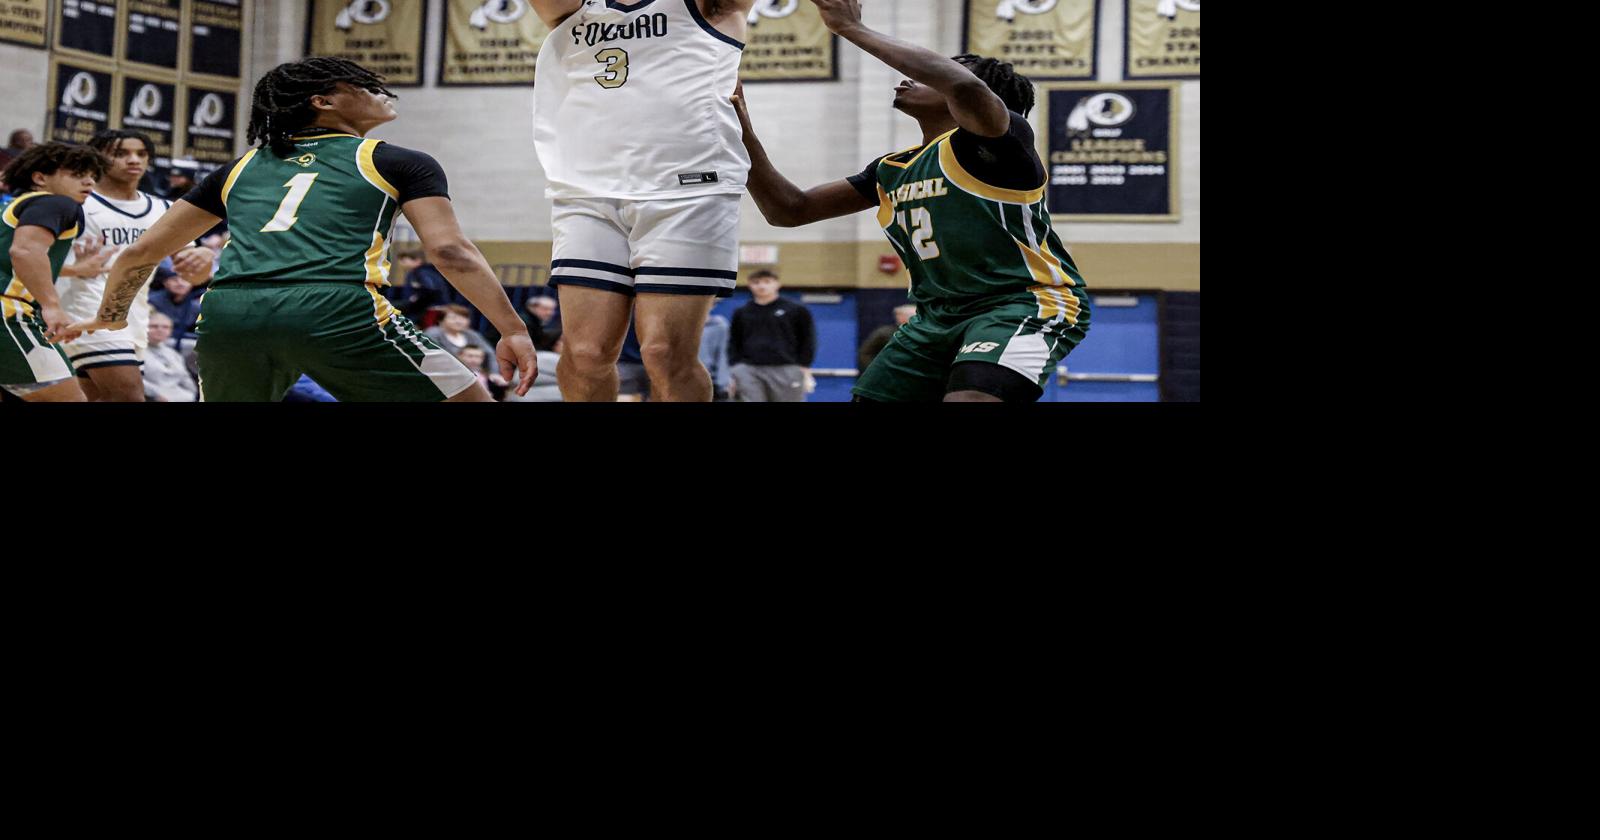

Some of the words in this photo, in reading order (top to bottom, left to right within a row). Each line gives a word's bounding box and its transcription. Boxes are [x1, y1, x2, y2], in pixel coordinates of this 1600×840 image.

[1003, 44, 1057, 54] STATE
[1165, 43, 1200, 53] STA
[593, 47, 630, 90] 3
[1072, 139, 1145, 151] LEAGUE
[1050, 150, 1166, 163] CHAMPIONS
[260, 171, 320, 234] 1
